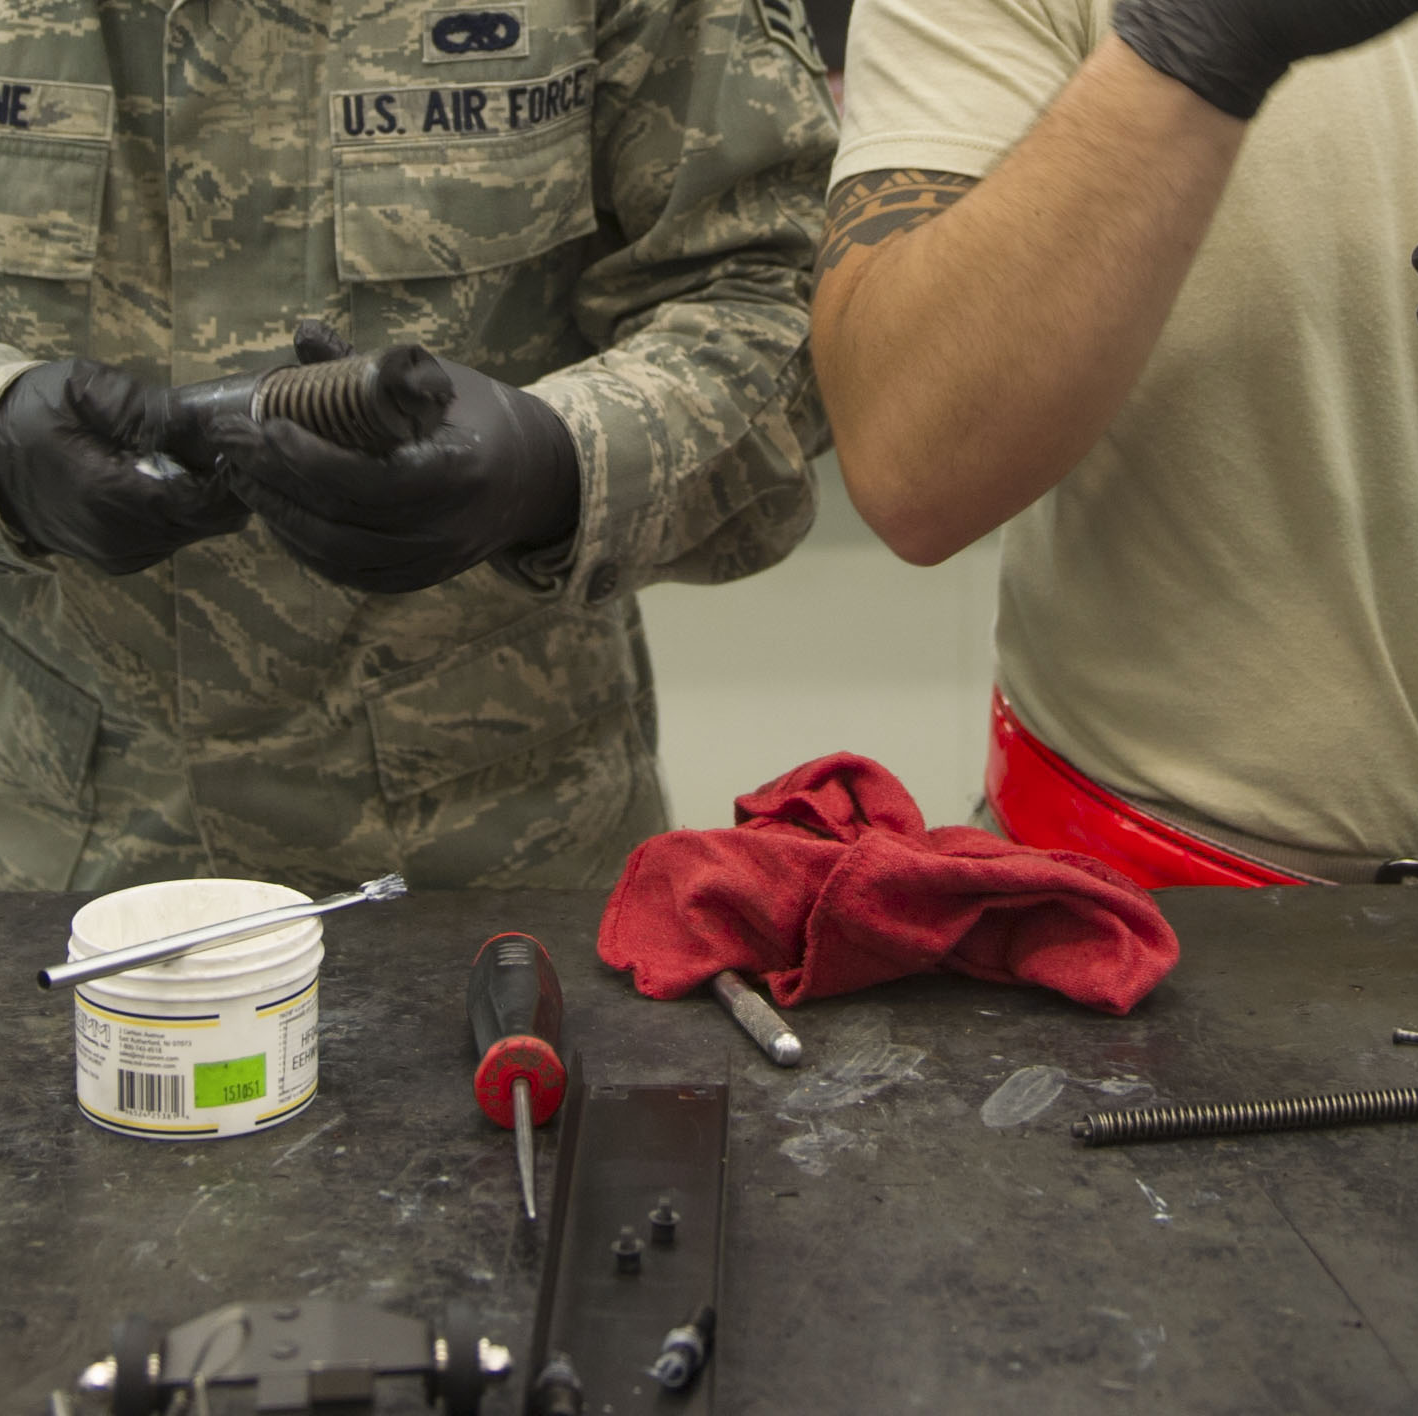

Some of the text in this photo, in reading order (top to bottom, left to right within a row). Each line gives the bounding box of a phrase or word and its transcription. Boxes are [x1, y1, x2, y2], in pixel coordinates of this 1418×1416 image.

[342, 67, 589, 137] U.S. AIR FORCE
